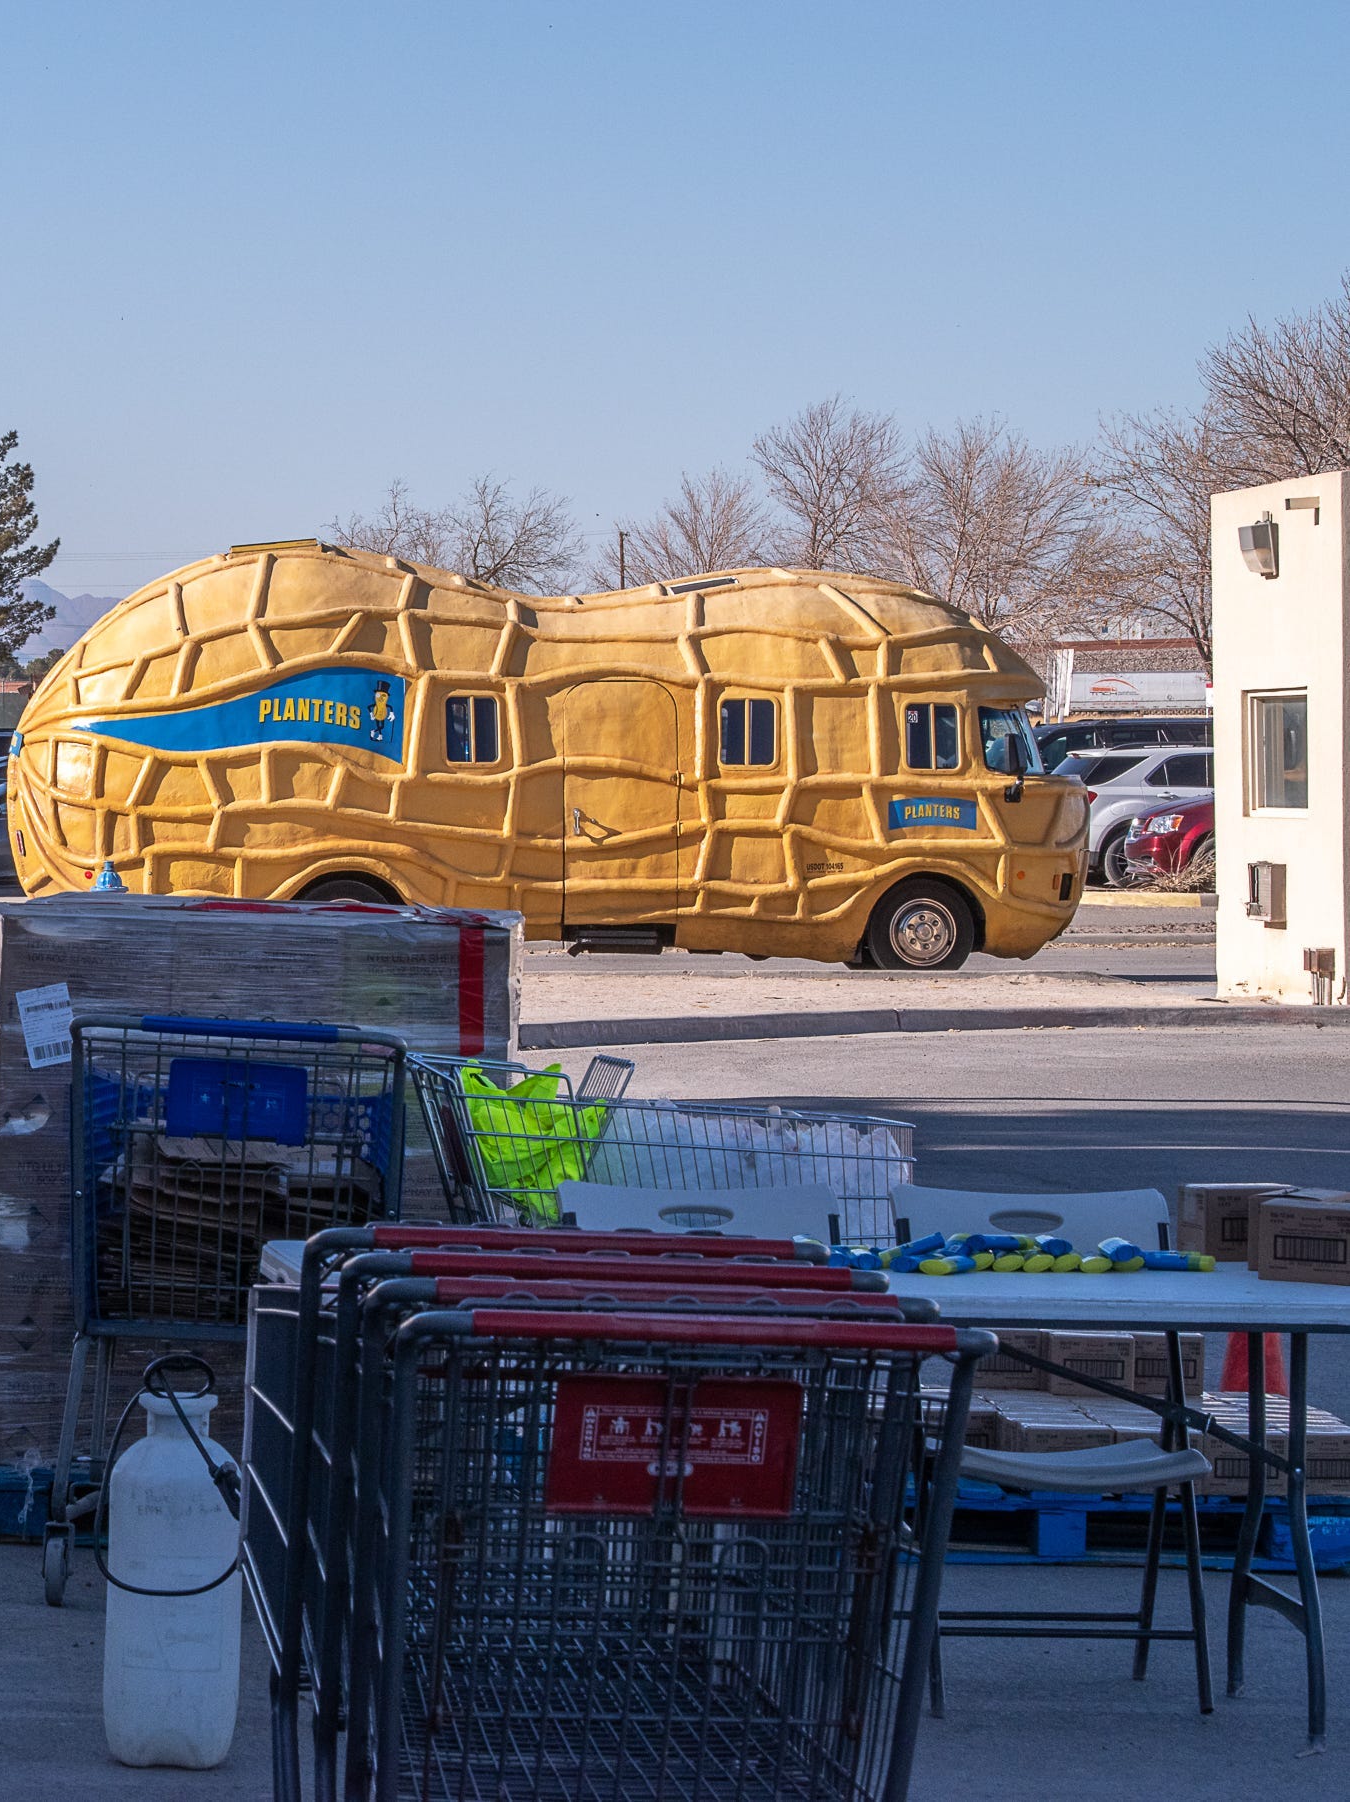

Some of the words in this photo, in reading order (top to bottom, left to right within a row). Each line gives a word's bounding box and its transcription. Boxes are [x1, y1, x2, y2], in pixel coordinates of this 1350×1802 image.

[258, 698, 362, 730] PLANTERS
[908, 713, 918, 723] 20
[904, 804, 961, 820] PLANTERS
[806, 863, 825, 871] USDOT
[751, 1422, 763, 1462] AVISO
